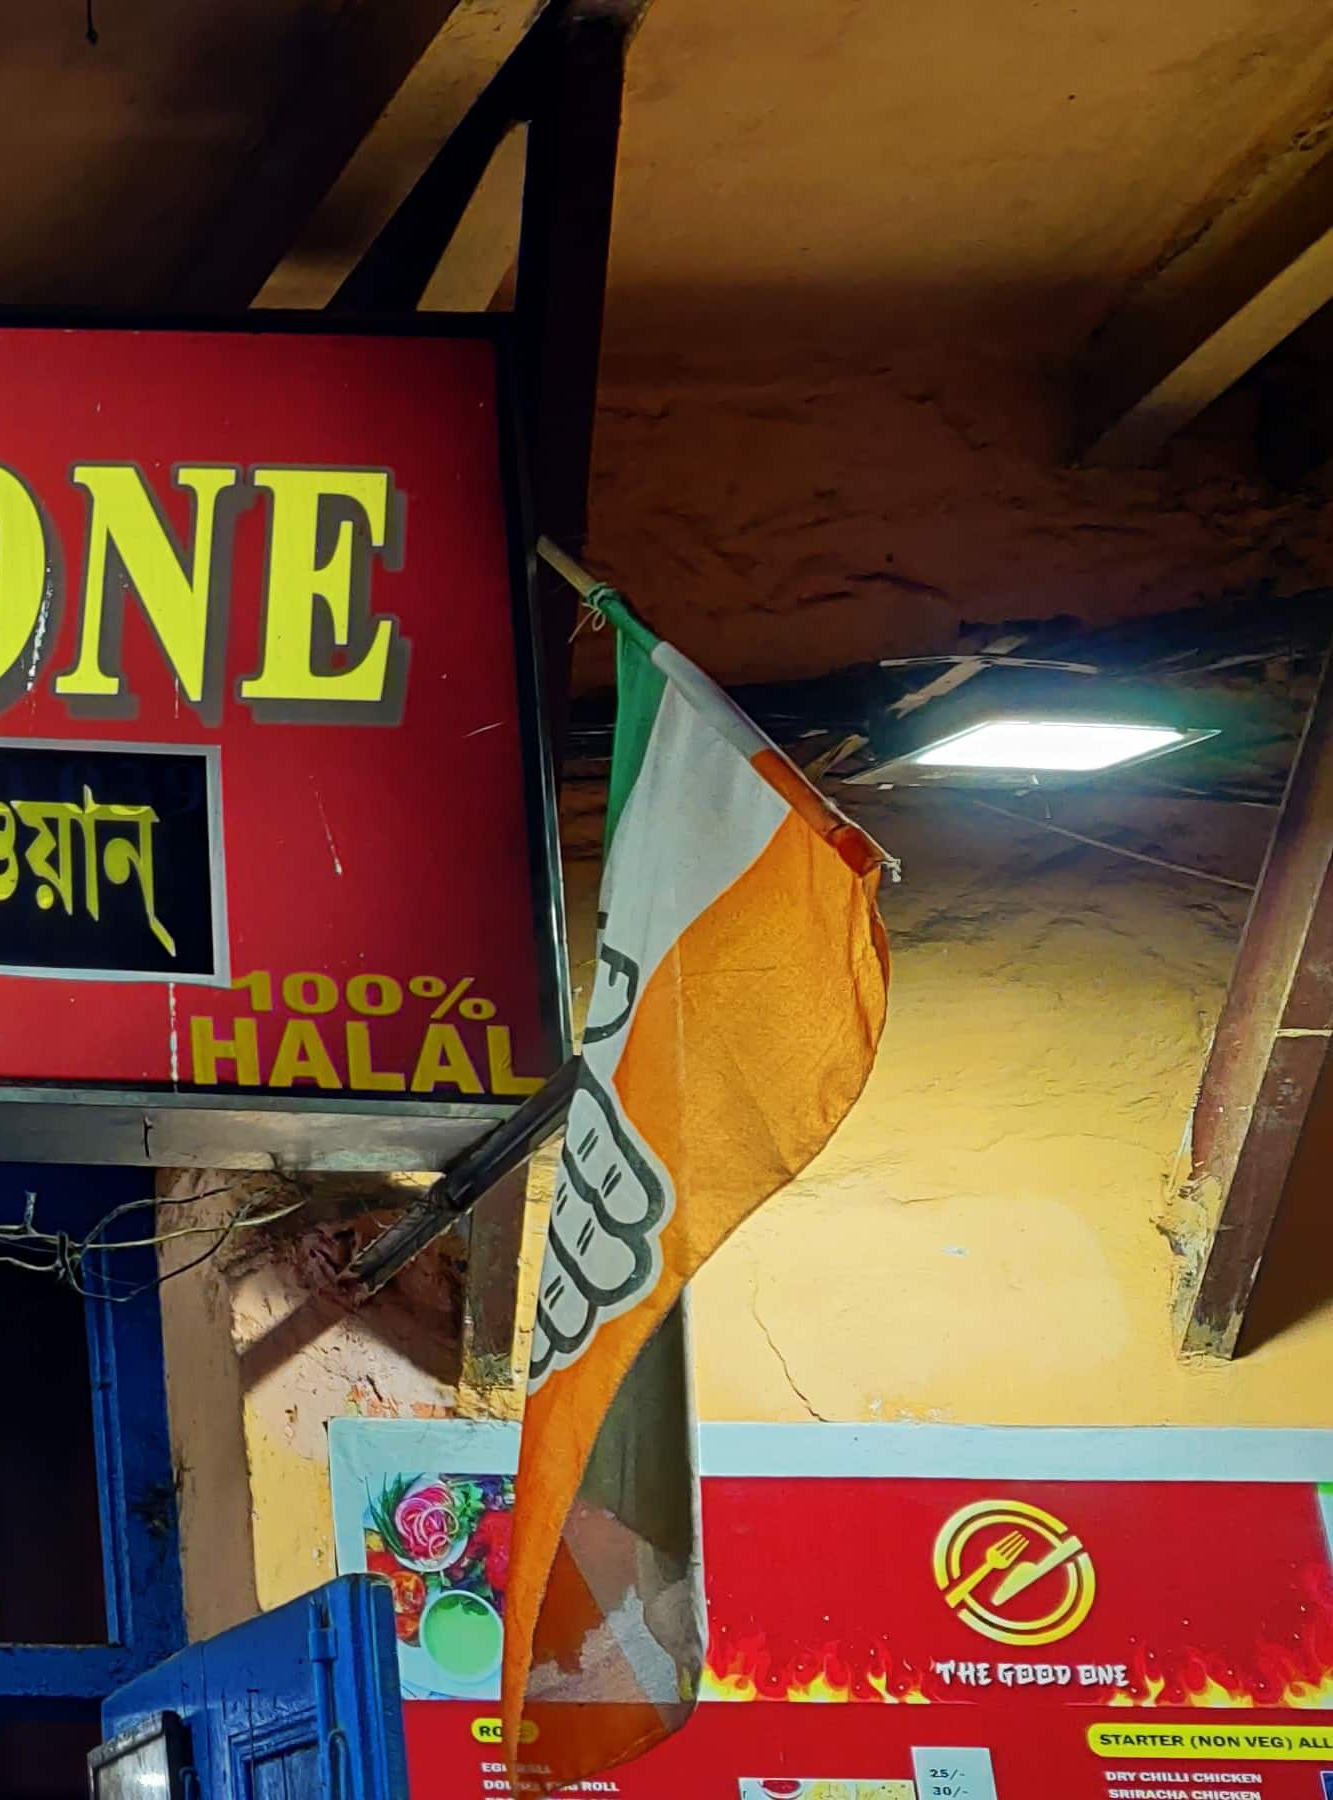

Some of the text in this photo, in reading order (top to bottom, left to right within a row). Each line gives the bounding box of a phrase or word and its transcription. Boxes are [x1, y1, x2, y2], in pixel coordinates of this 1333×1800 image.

[230, 970, 497, 1021] 100%
[189, 1015, 549, 1096] HALAL
[935, 1659, 1131, 1688] THE GOOD ONE
[1100, 1733, 1184, 1747] STARTER
[1191, 1734, 1241, 1750] (NON
[1244, 1735, 1293, 1751] VEG)
[930, 1768, 965, 1781] 25/-
[1104, 1770, 1263, 1784] DRY CHILLI CHICKEN
[581, 1781, 620, 1792] ROLL
[932, 1786, 969, 1798] 30/-
[1108, 1788, 1262, 1800] SRIRACHA CHICKEN
